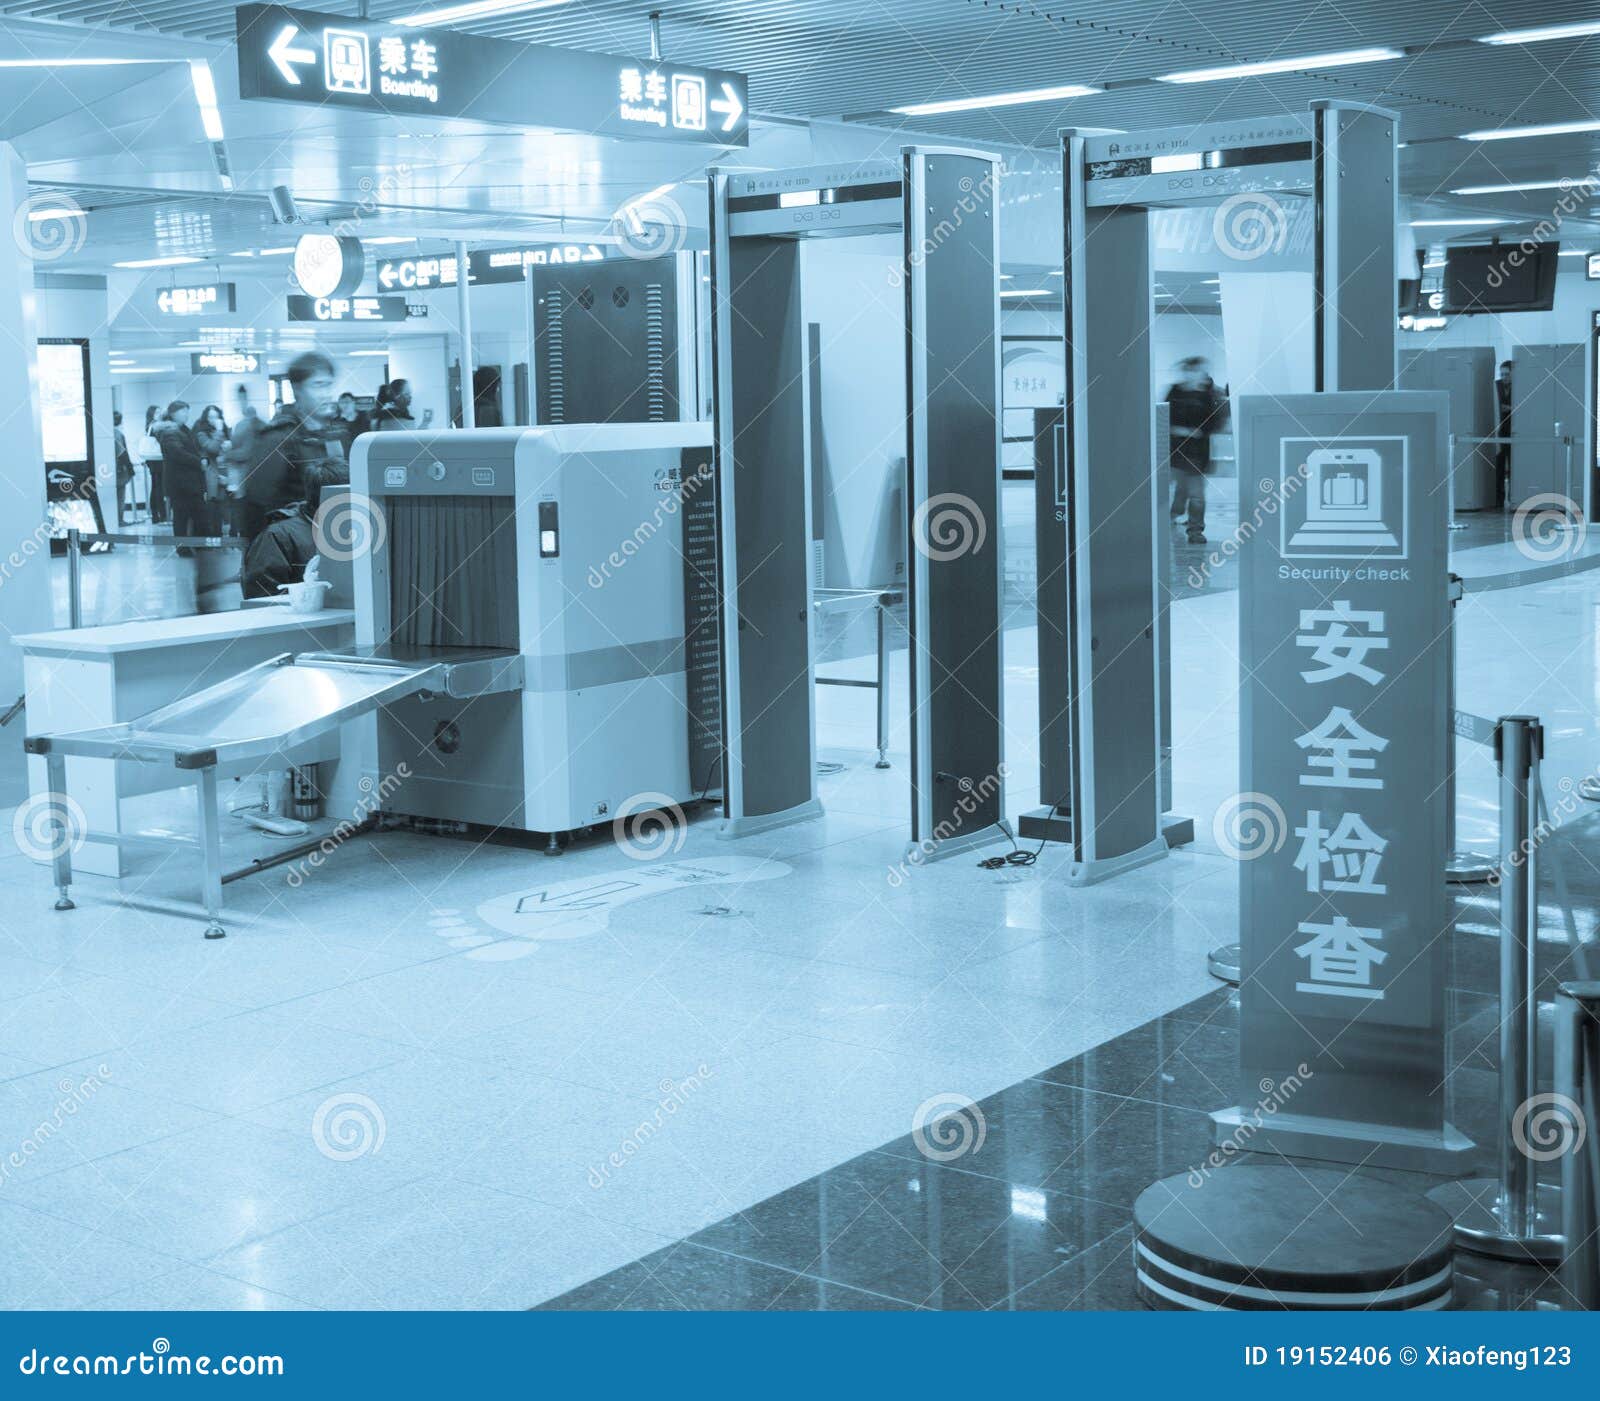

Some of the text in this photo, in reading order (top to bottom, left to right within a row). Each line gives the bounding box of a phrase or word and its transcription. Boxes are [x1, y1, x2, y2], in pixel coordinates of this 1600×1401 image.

[379, 37, 438, 79] 乘车
[380, 76, 438, 102] Boarding
[619, 68, 667, 107] 乘车
[399, 261, 416, 288] C
[314, 298, 331, 320] C
[1278, 565, 1351, 584] Security
[1293, 600, 1390, 1000] 安全检查
